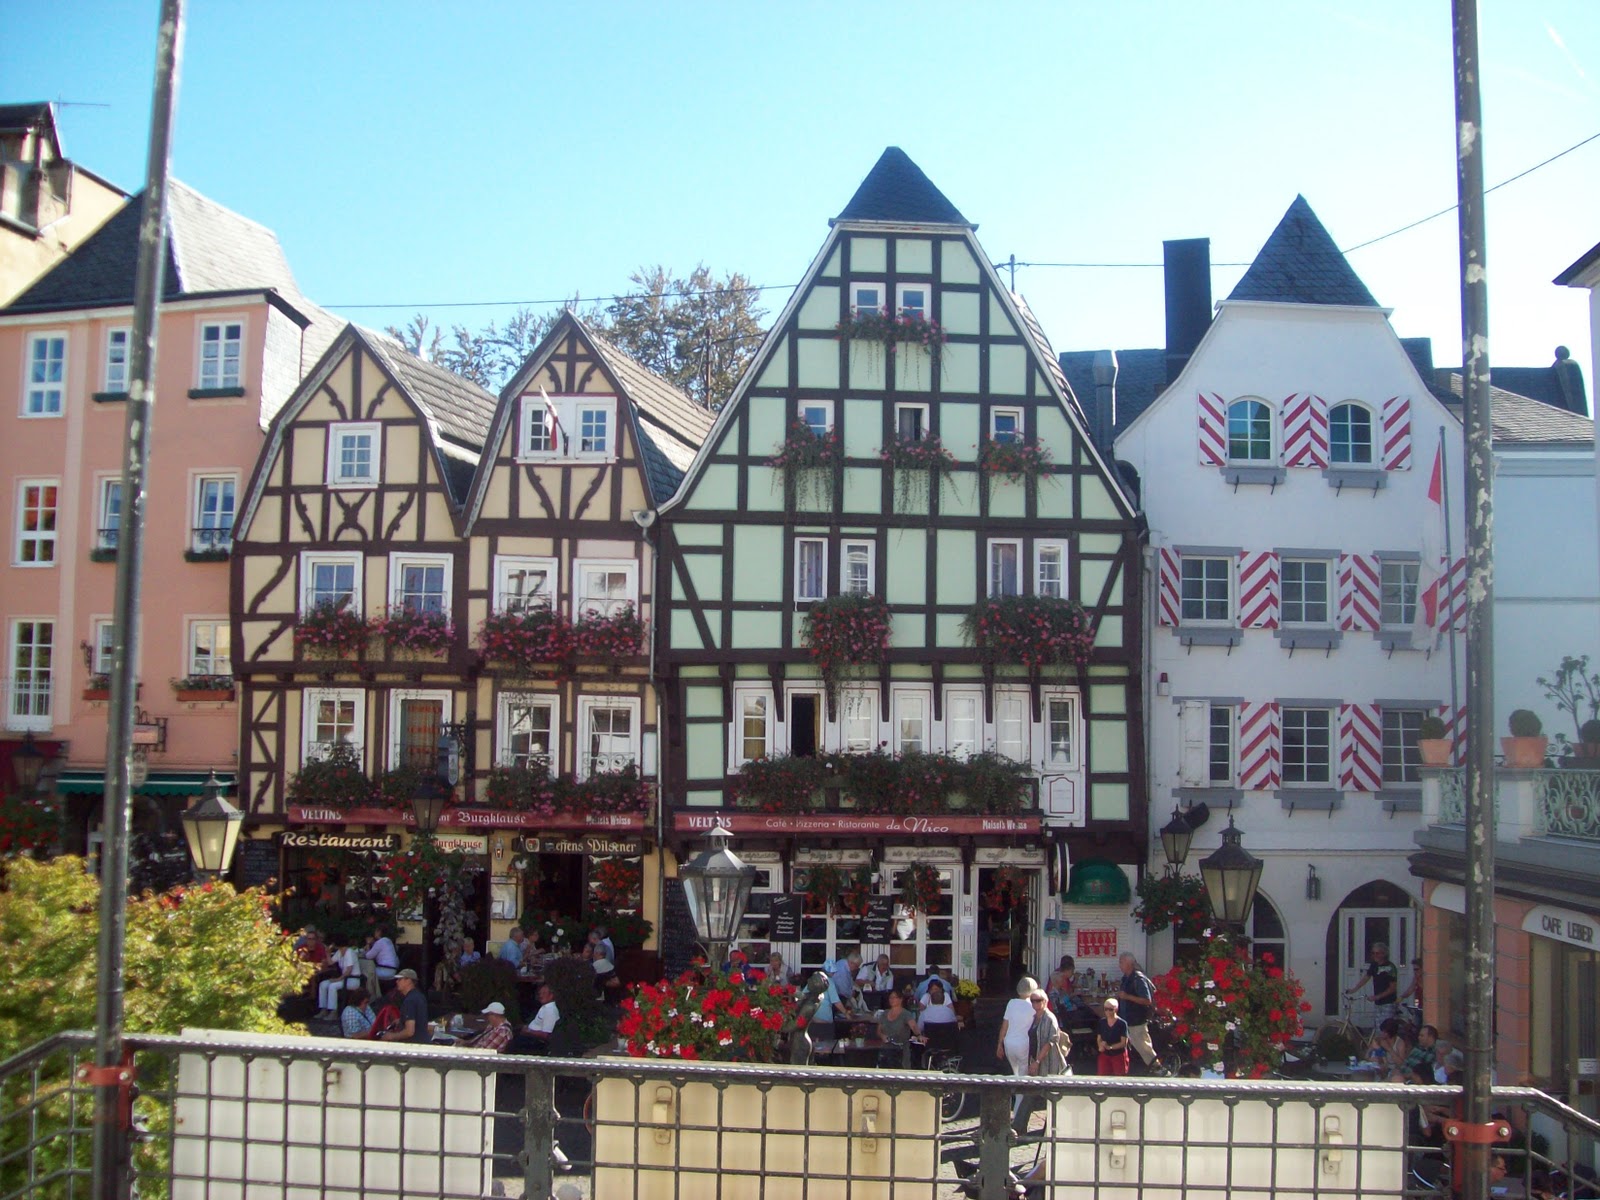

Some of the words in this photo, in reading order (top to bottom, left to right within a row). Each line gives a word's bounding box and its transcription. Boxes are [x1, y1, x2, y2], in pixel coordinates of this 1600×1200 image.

[301, 808, 342, 820] VELTINS
[458, 811, 526, 825] Burgklause
[688, 816, 732, 828] VELTNS
[765, 818, 787, 828] Café
[838, 819, 880, 829] Ristorante
[886, 818, 901, 830] da
[903, 816, 949, 833] Nico
[281, 831, 394, 848] Restaurant
[545, 840, 584, 853] effens
[1542, 914, 1562, 935] CAFE
